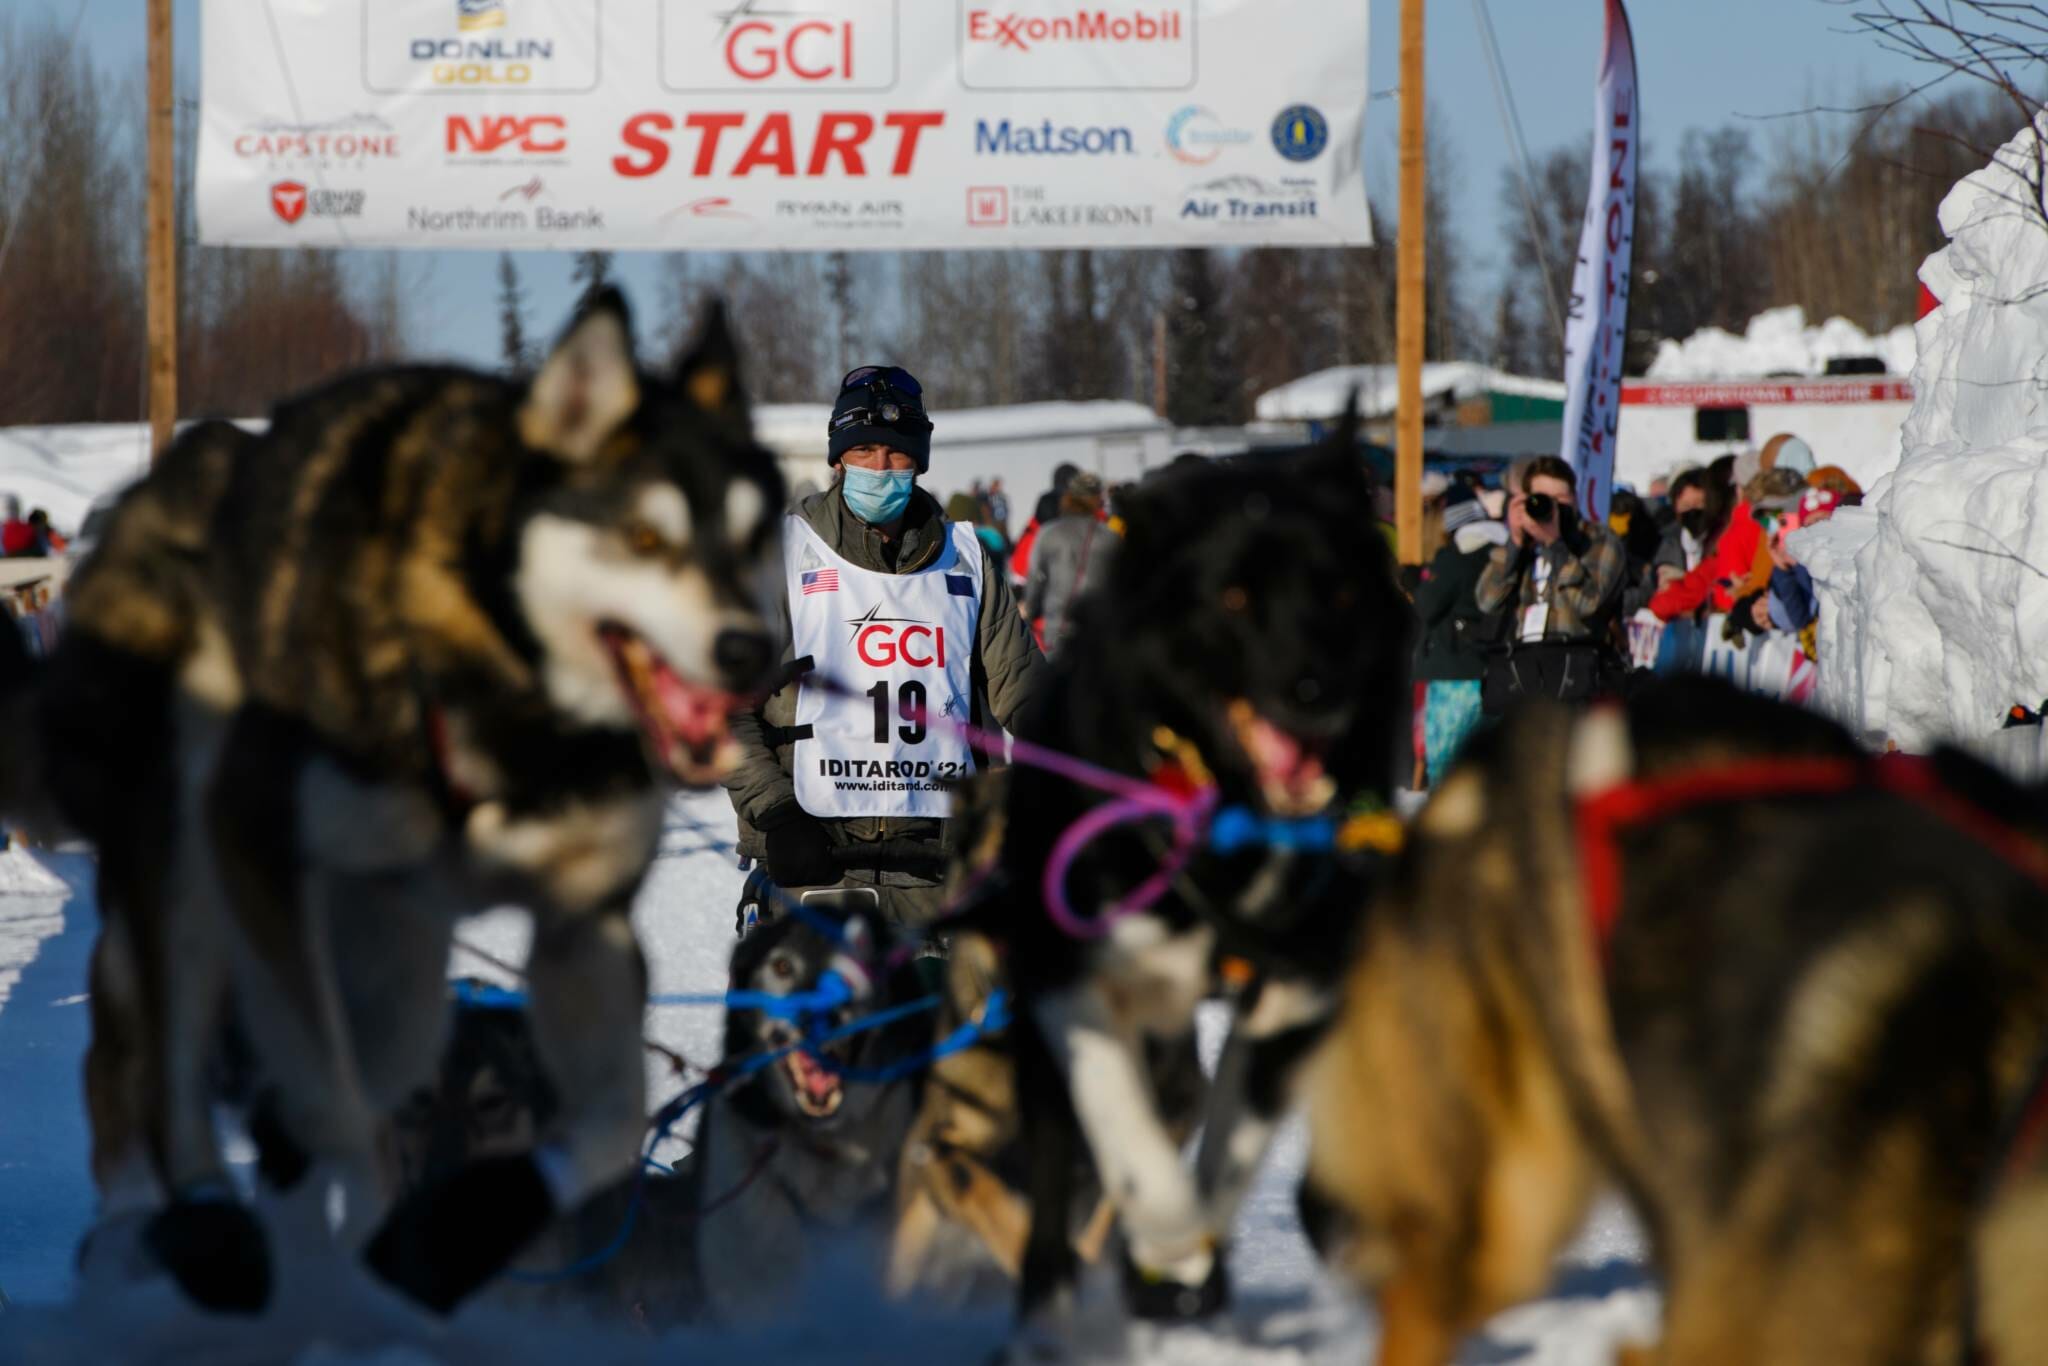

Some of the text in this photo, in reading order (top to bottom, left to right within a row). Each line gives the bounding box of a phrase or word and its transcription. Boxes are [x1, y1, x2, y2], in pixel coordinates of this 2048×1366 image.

[968, 10, 1181, 51] ExxonMobil
[410, 39, 553, 60] DONLIN
[725, 20, 853, 80] GCI
[433, 64, 531, 84] GOLD
[234, 133, 400, 158] CAPSTONE
[446, 115, 567, 153] NAC
[611, 110, 945, 178] START
[975, 118, 1133, 154] Matson
[408, 205, 604, 231] Northrim Bank
[1181, 199, 1318, 218] Air Transit
[857, 624, 945, 668] GCI
[866, 680, 927, 744] 19
[820, 759, 930, 778] IDITAROD
